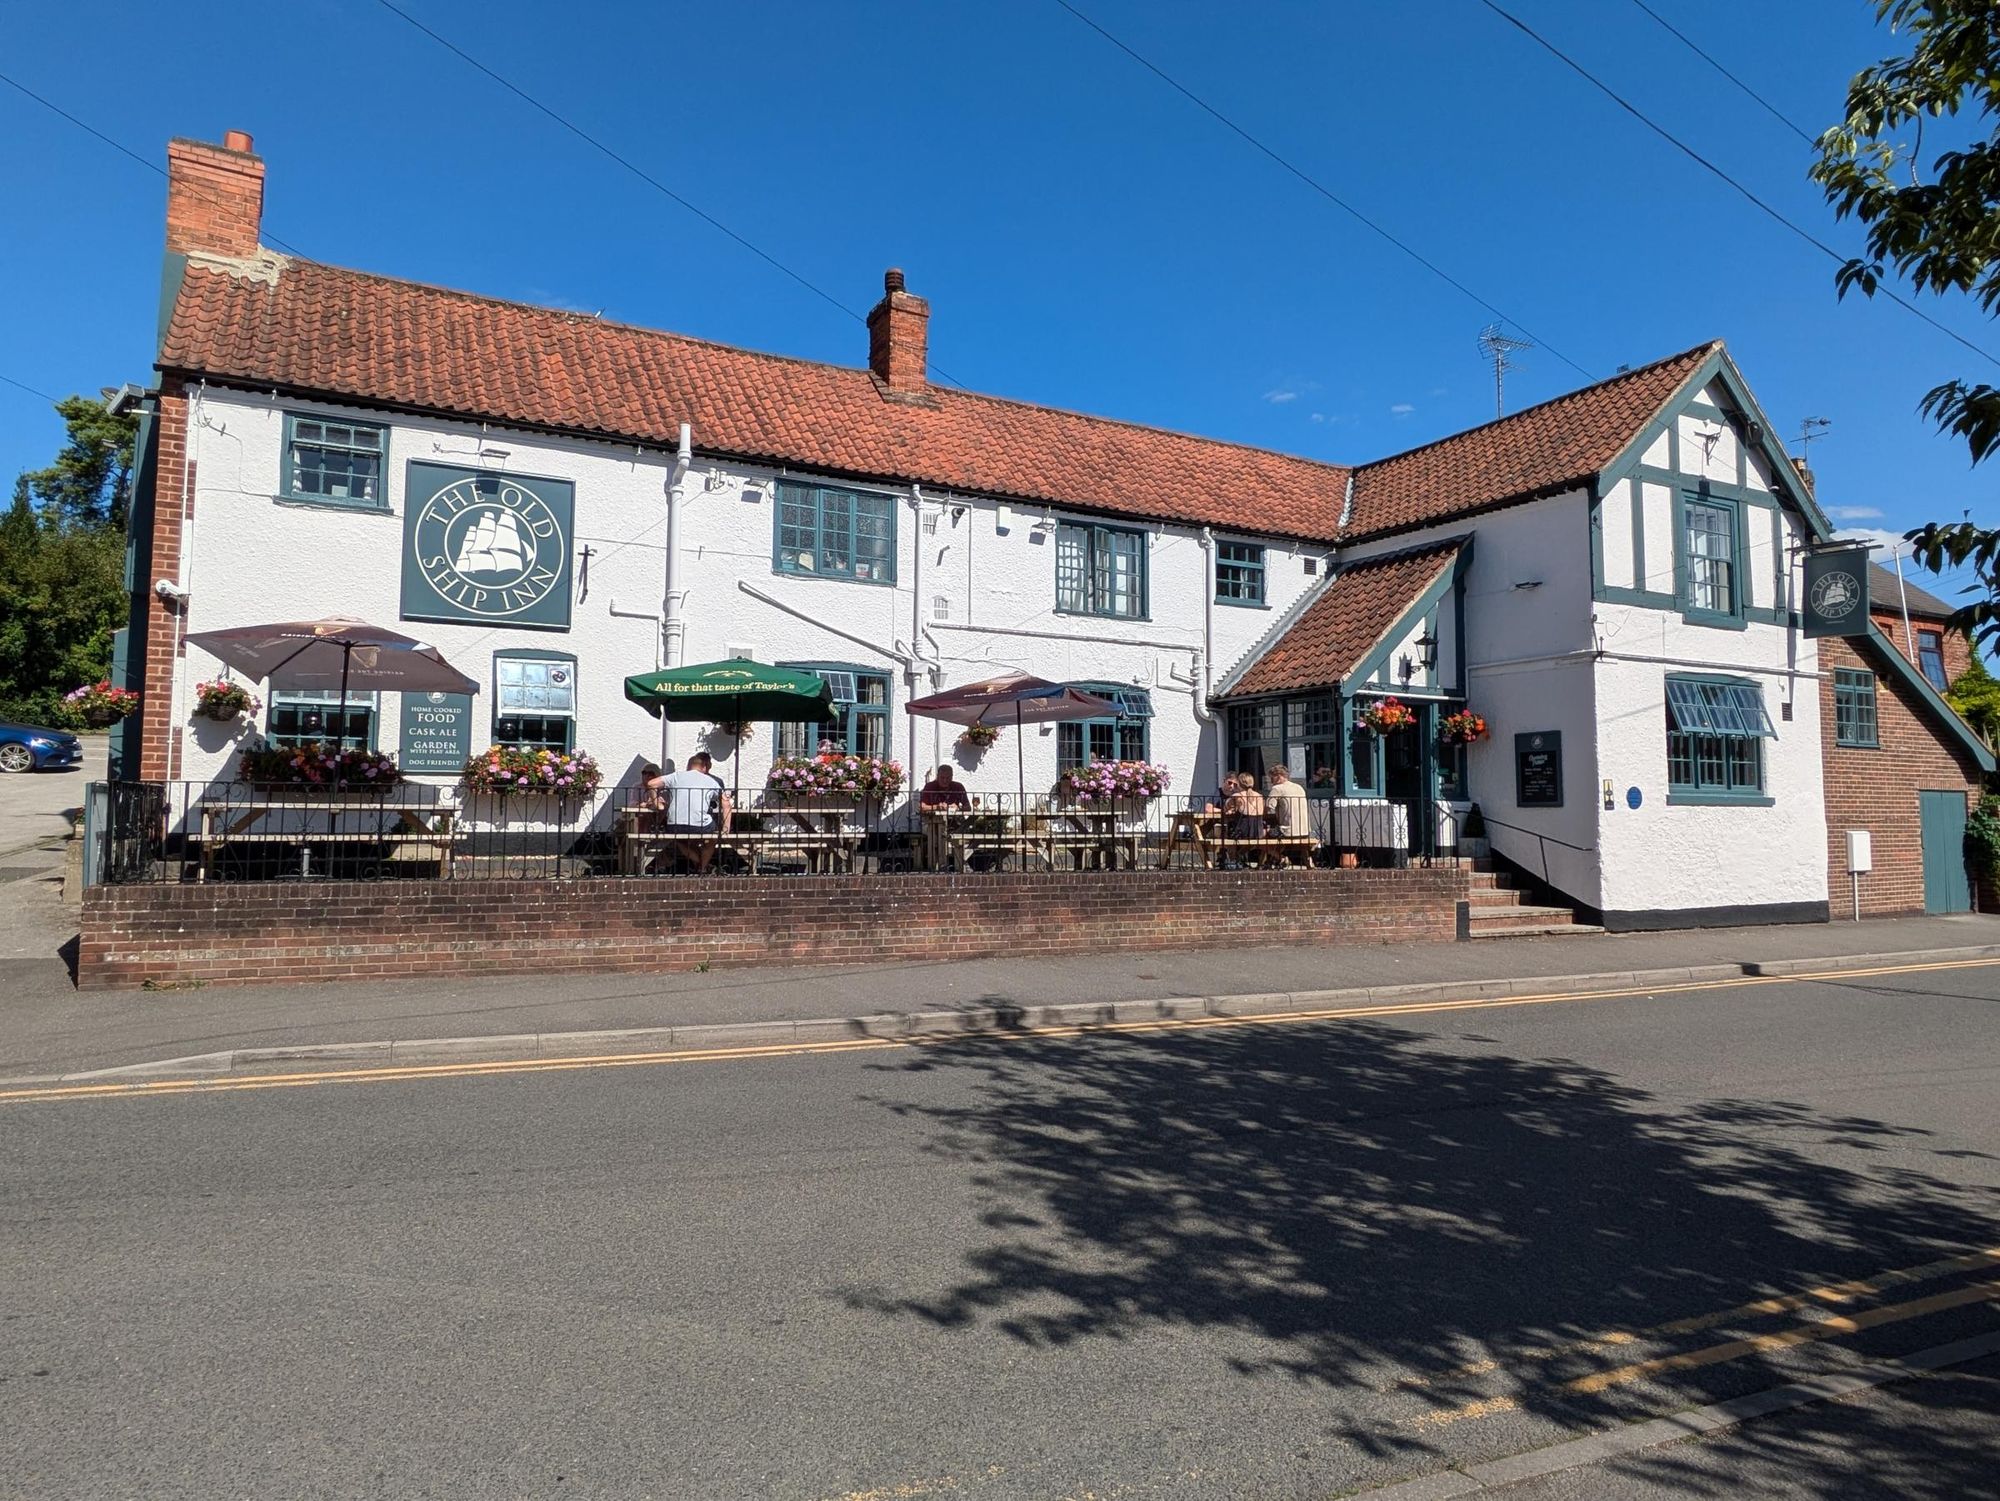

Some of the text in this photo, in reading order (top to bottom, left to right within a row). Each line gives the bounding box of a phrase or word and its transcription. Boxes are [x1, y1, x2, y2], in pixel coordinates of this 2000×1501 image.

[425, 483, 554, 538] THE OLD
[423, 555, 555, 610] SHIP INN
[1814, 573, 1856, 592] THE OLD
[1813, 597, 1857, 616] SHIP INN
[655, 681, 796, 692] All for that taste of Taylor's
[418, 713, 456, 723] FOOD
[408, 727, 457, 737] CASK ALE
[413, 741, 457, 749] GARDEN
